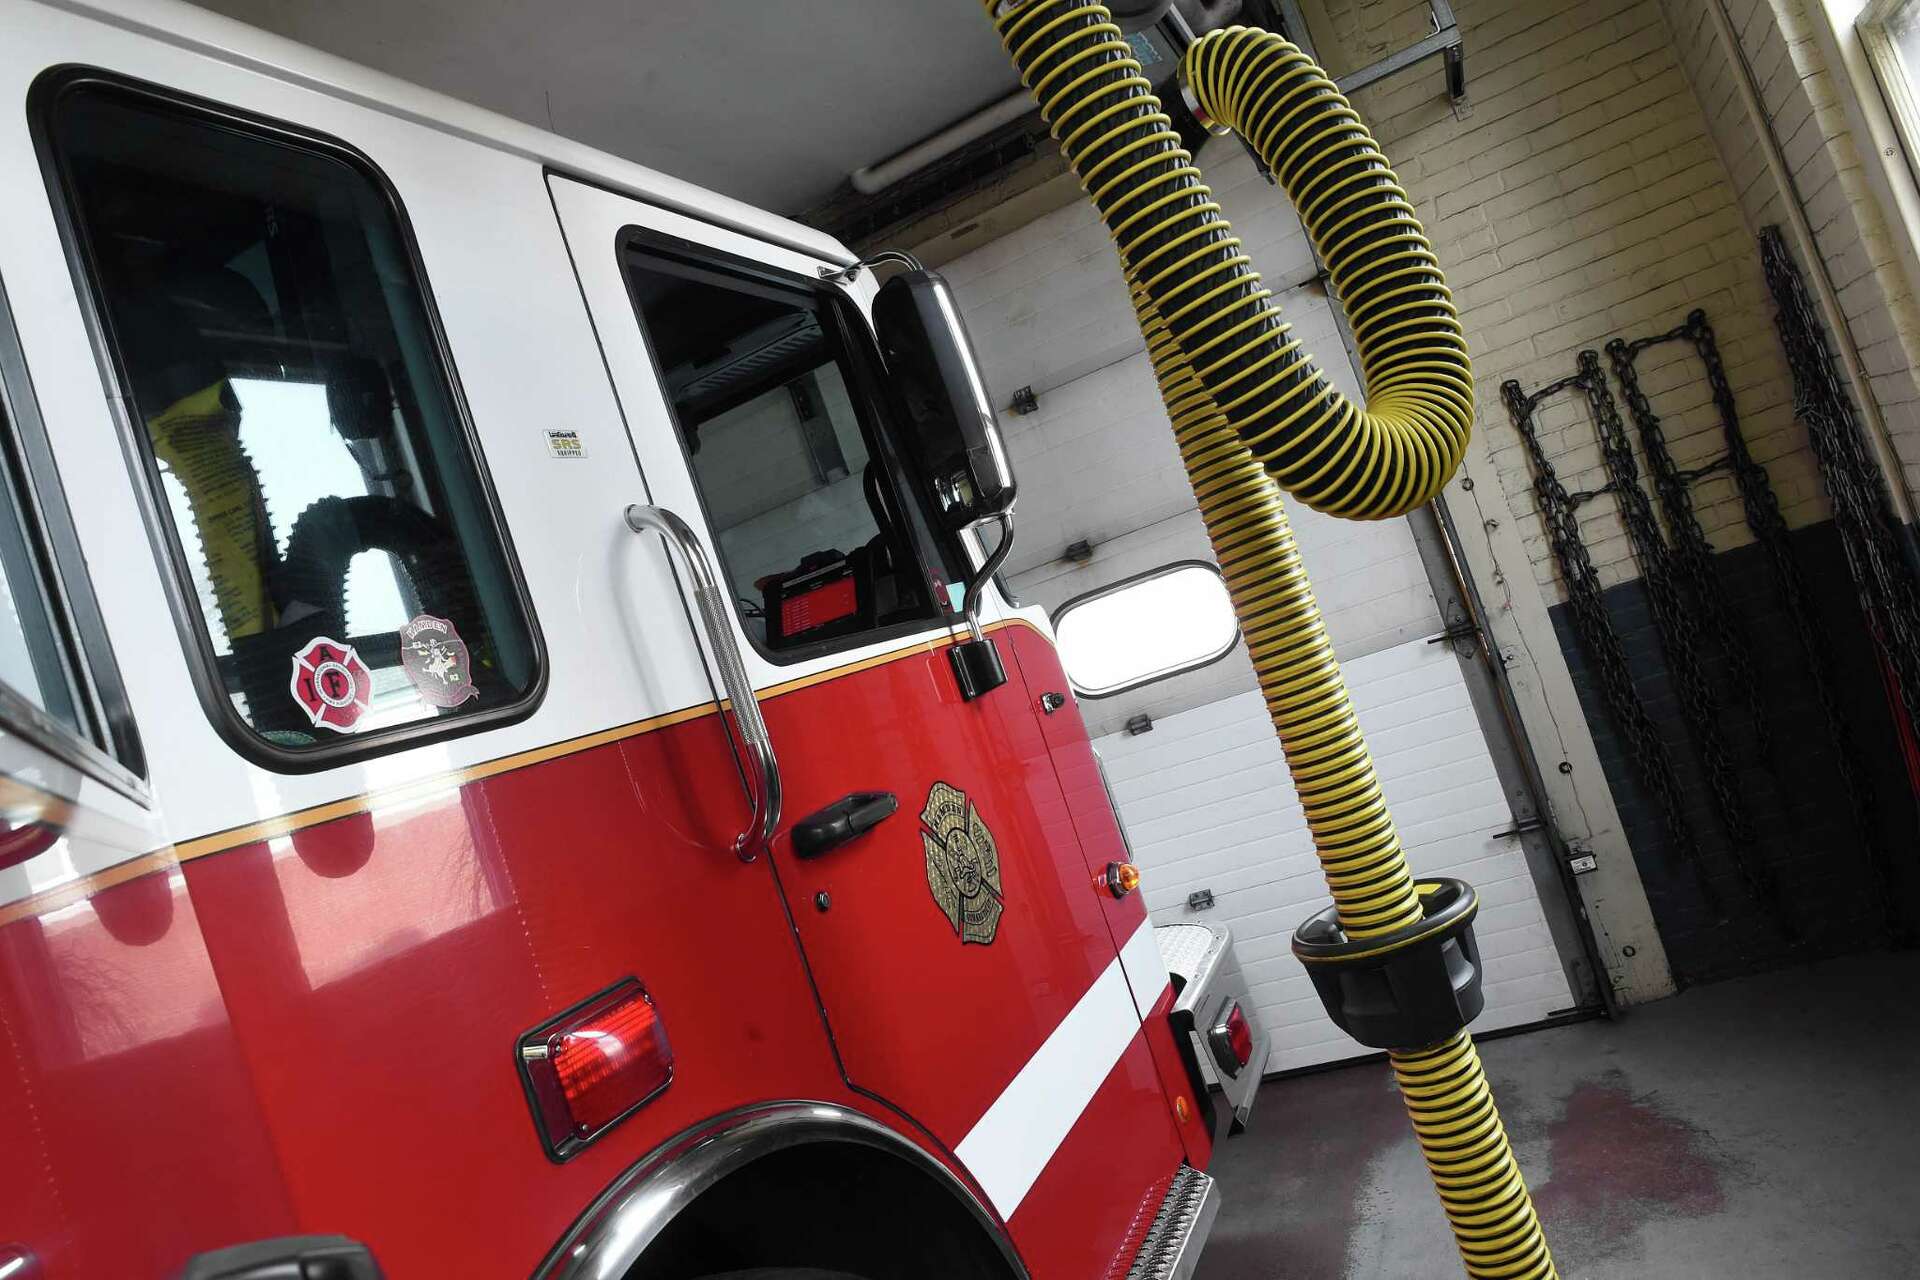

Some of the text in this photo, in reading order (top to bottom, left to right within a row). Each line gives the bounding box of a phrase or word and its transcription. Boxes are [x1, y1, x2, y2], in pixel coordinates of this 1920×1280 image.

[551, 439, 581, 449] SRS
[320, 646, 334, 661] A
[303, 678, 318, 702] I
[326, 671, 343, 699] F
